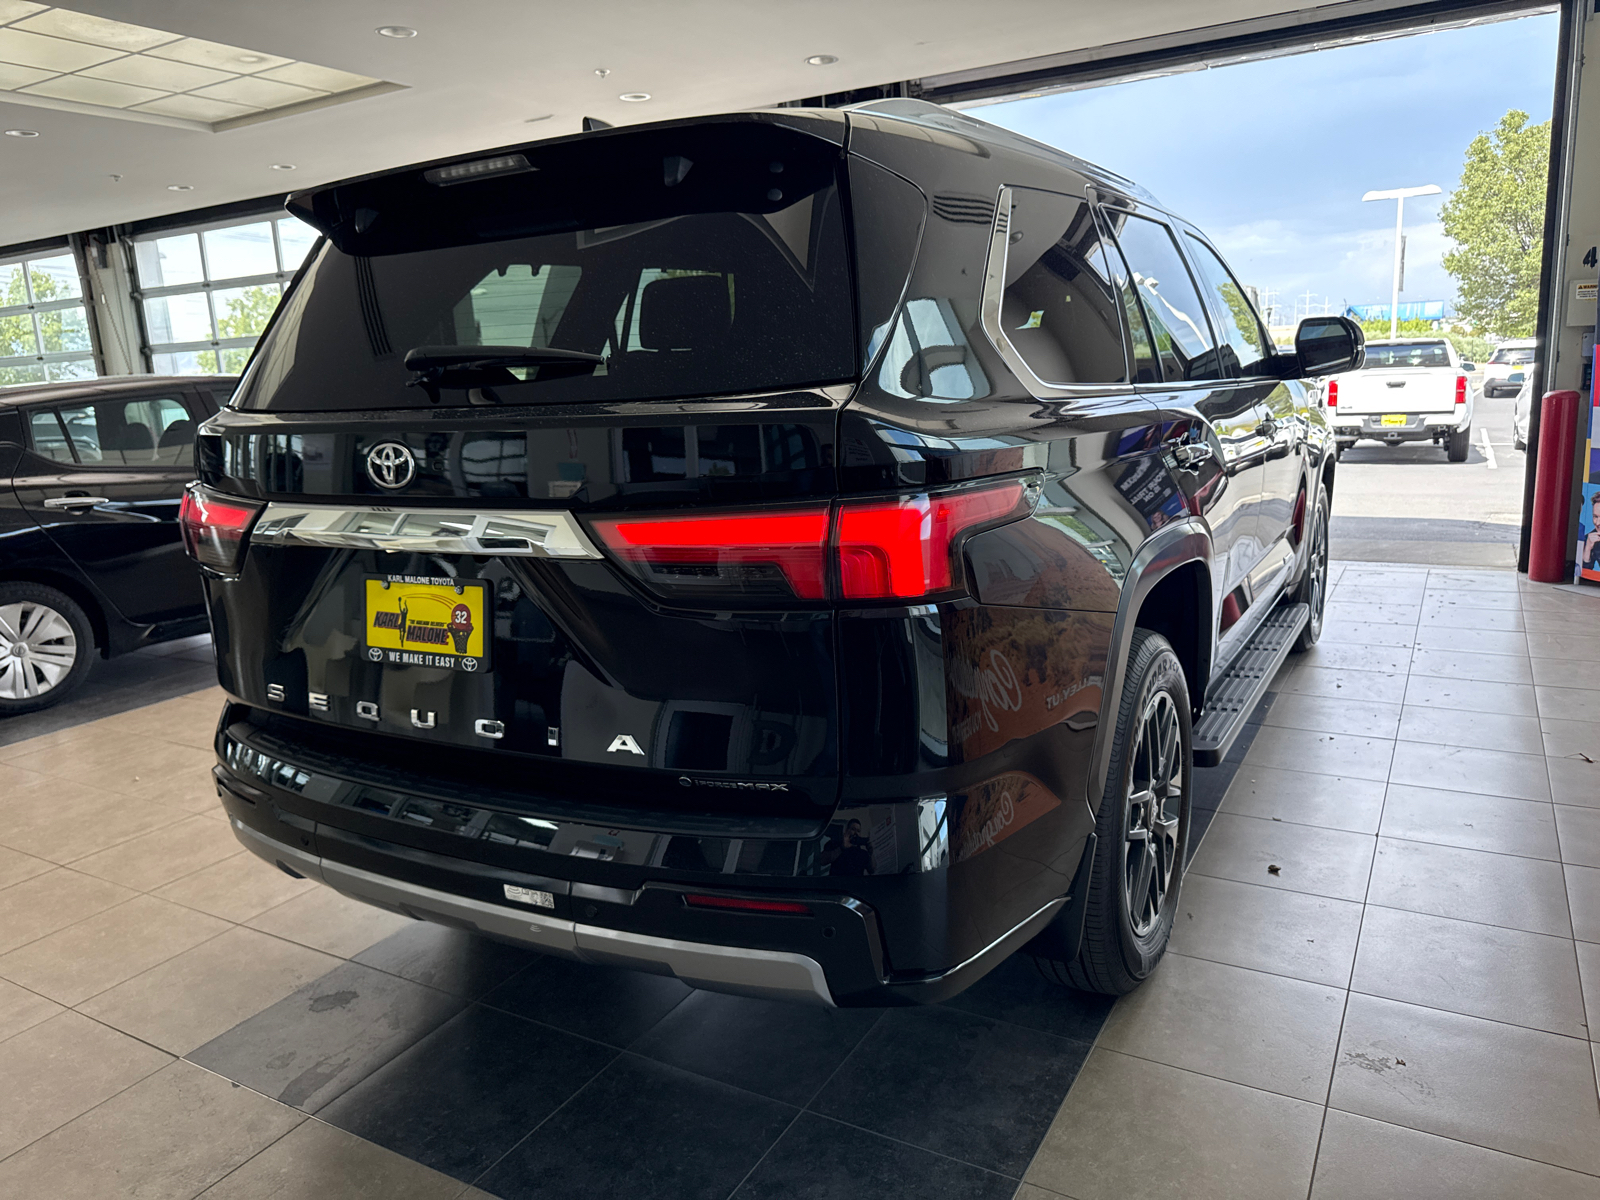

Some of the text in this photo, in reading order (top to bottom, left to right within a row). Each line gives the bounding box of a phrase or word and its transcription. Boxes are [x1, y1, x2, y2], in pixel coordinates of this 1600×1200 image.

[1583, 246, 1598, 268] 4
[388, 574, 454, 586] KARL MALONE TOYOTA
[373, 611, 401, 629] KARL
[455, 610, 468, 624] 32
[406, 625, 449, 645] MALONE
[389, 651, 455, 668] WE MAKE IT EASY
[267, 683, 645, 755] SEQUOIA
